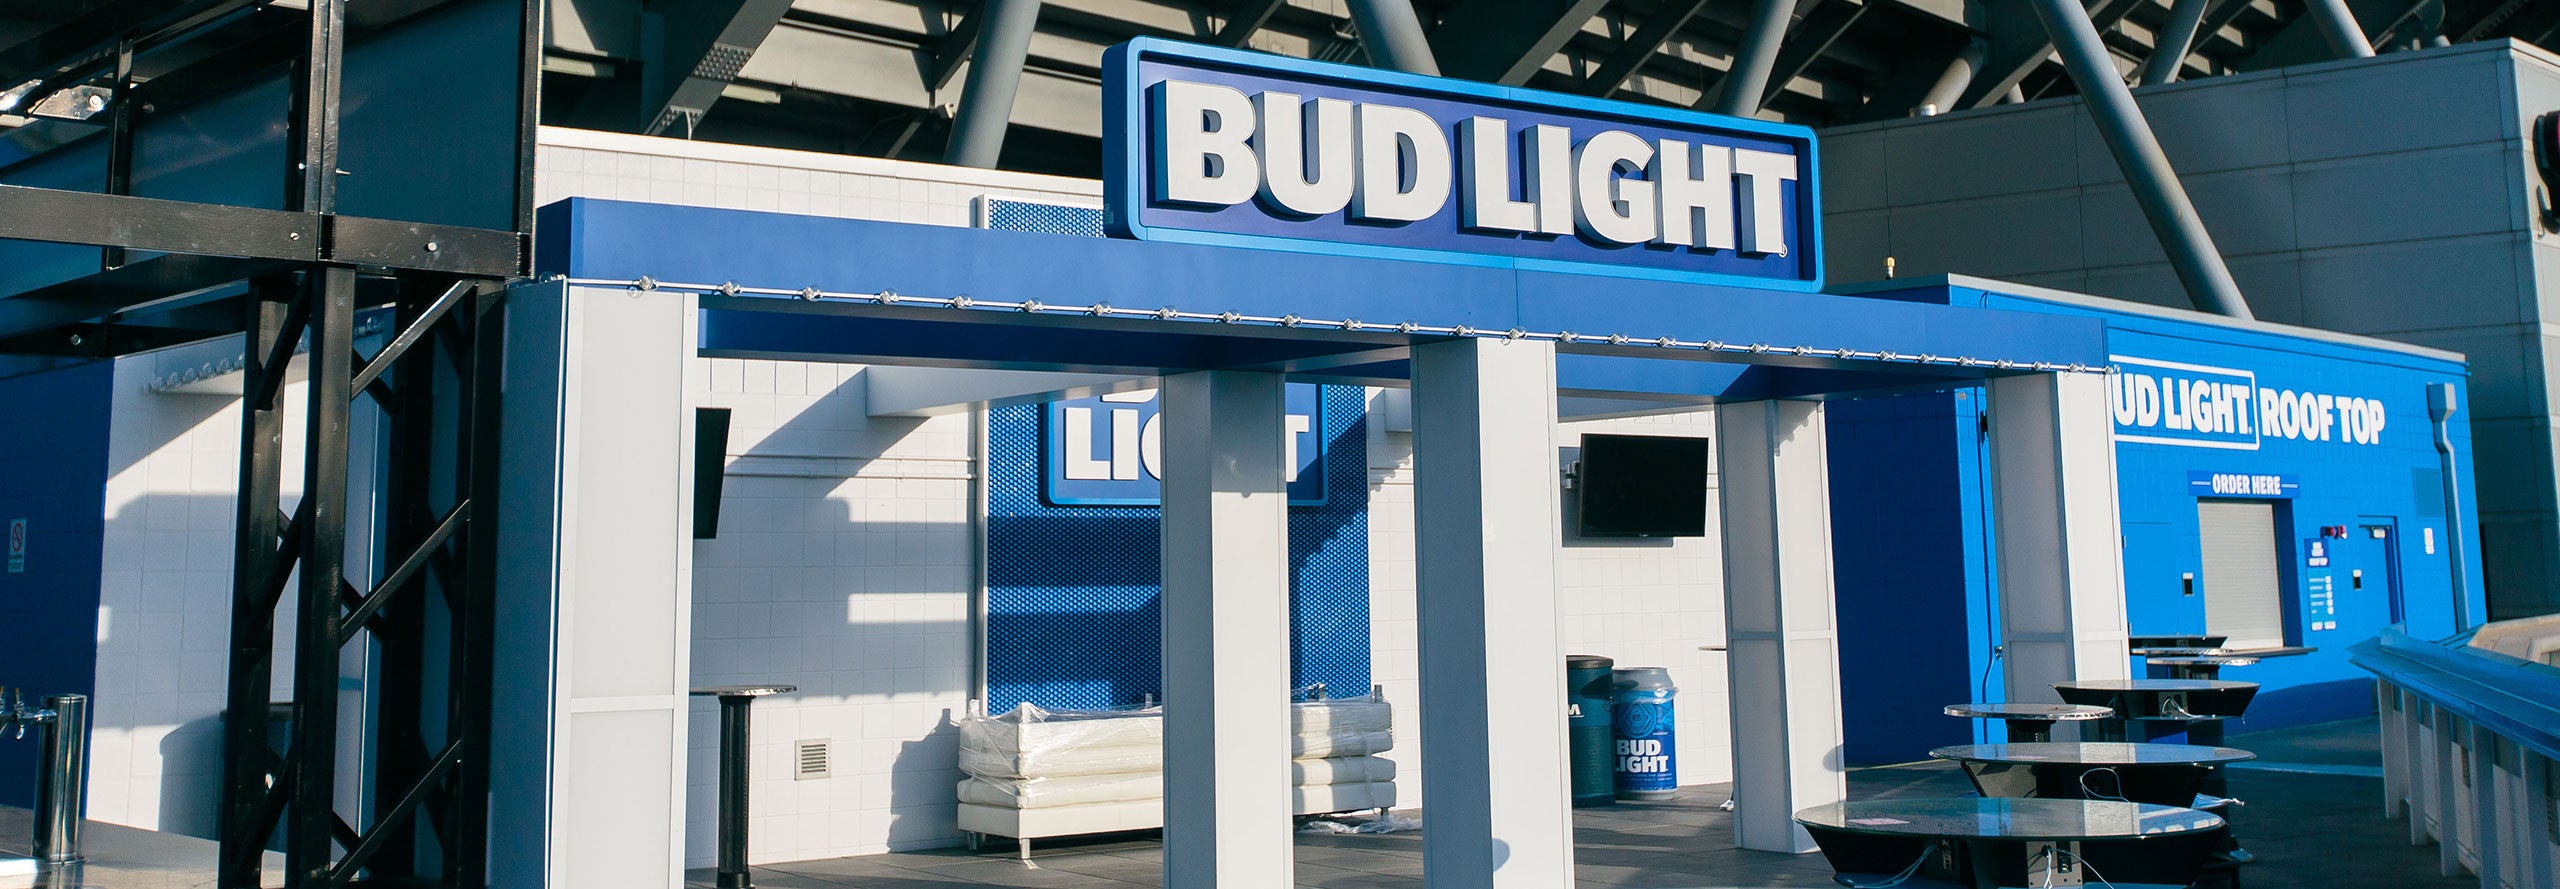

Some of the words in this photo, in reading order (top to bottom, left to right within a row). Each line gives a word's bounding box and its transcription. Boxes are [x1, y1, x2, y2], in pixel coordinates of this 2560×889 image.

[1158, 79, 1452, 221] BUD
[1468, 115, 1797, 256] LIGHT
[2112, 372, 2160, 427] UD
[2162, 377, 2250, 434] LIGHT
[2259, 388, 2334, 441] ROOF
[2335, 396, 2385, 445] TOP
[2212, 473, 2250, 494] ORDER
[2252, 475, 2281, 495] HERE
[1616, 739, 1661, 756] BUD
[1616, 755, 1669, 773] IGHT
